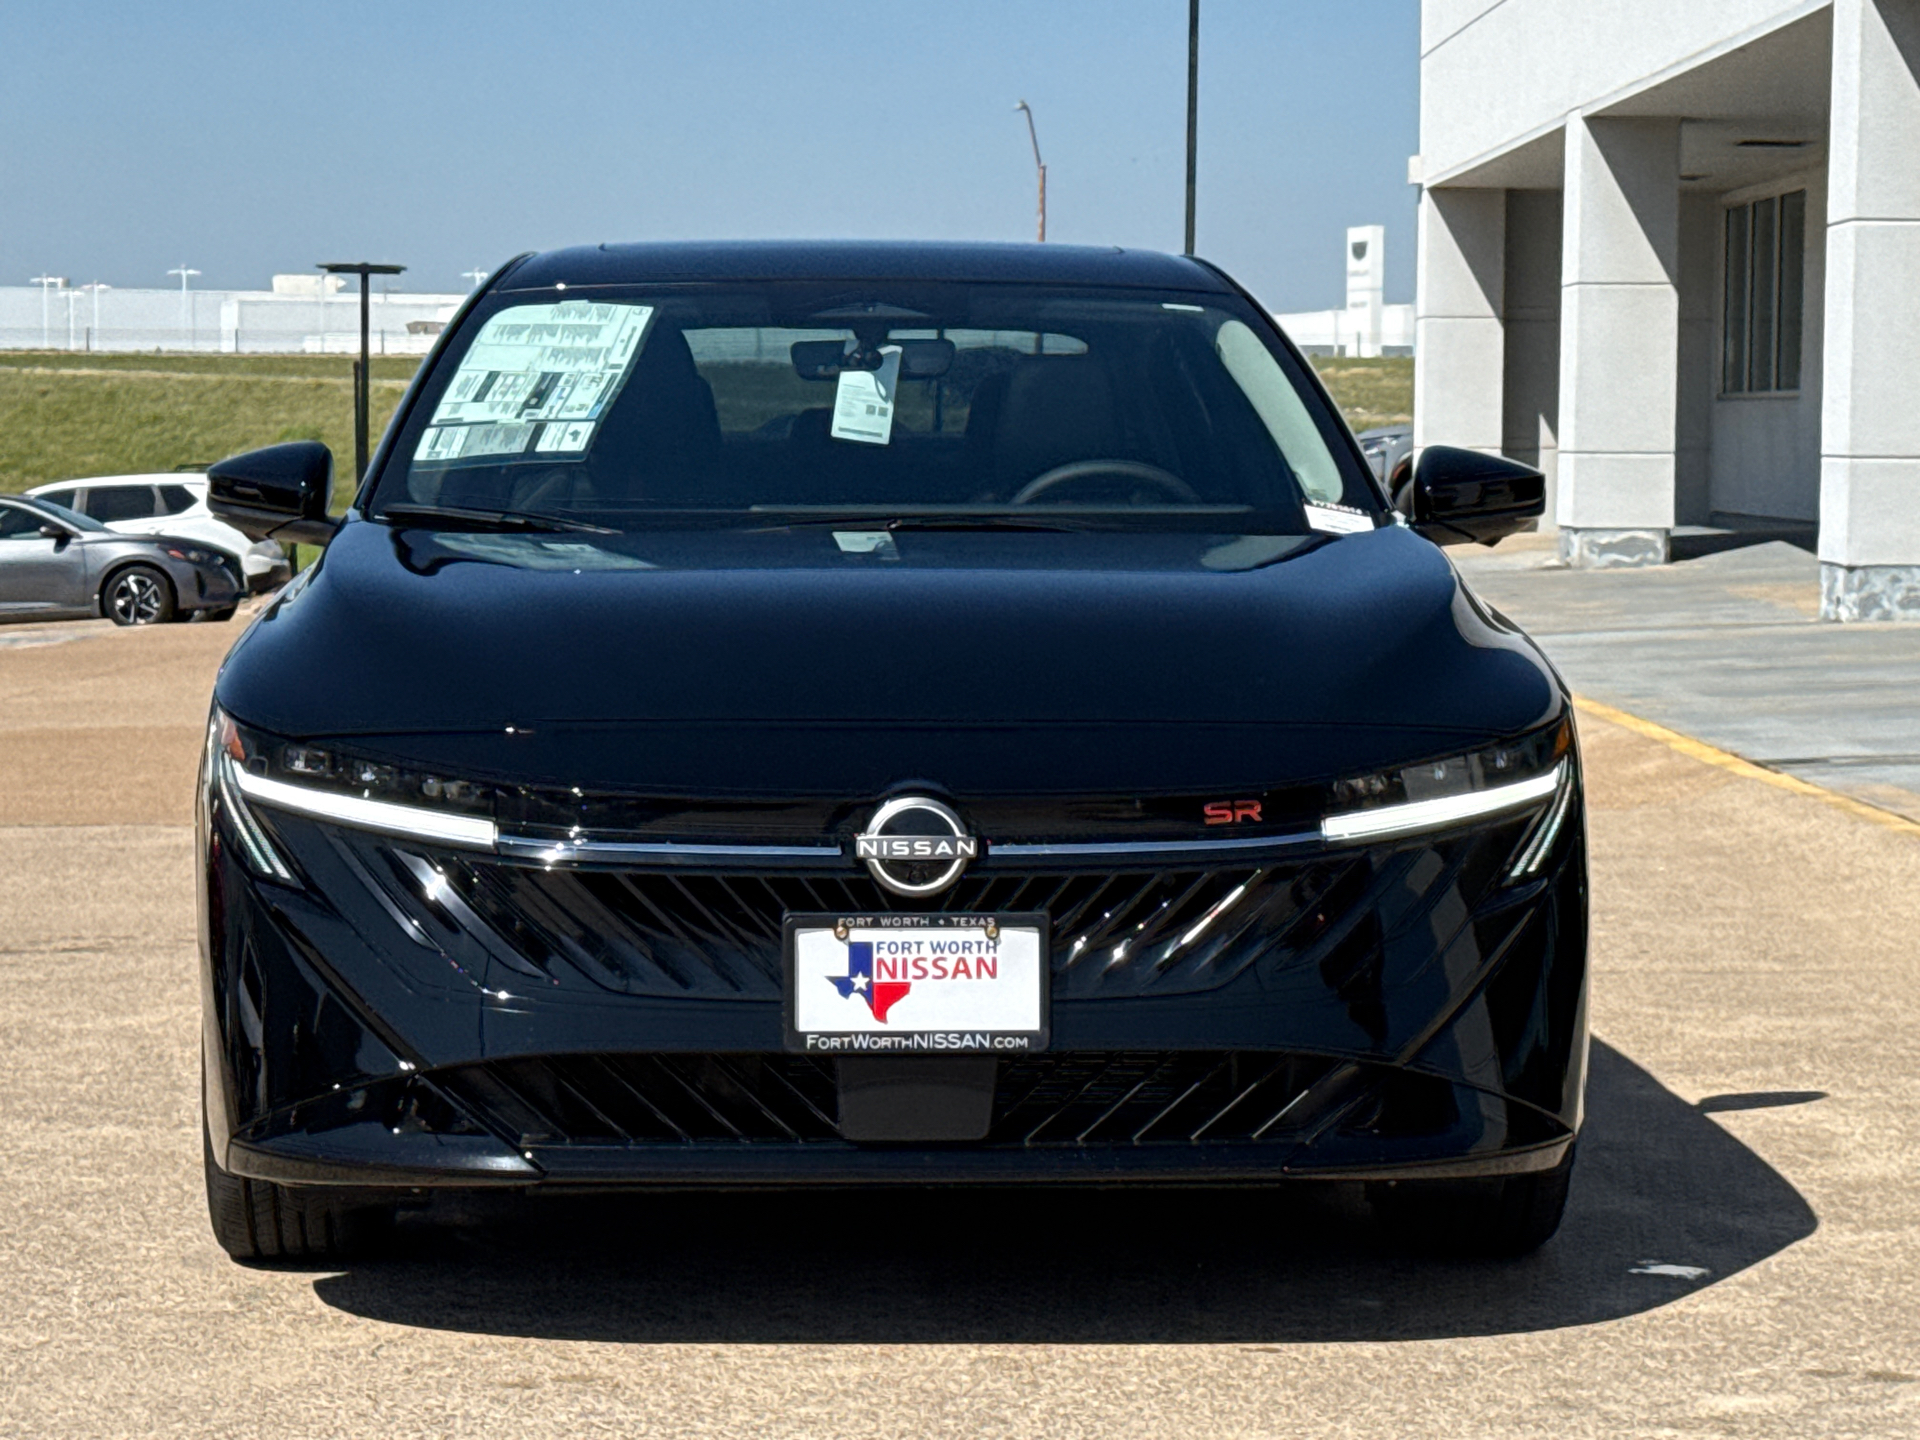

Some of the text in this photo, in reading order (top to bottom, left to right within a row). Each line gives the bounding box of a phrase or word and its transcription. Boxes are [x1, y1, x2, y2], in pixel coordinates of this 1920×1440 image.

[1204, 800, 1263, 825] SR
[859, 840, 975, 856] NISSAN
[838, 916, 995, 927] FORT WORTH TEXAS
[876, 940, 998, 955] FORT WORTH
[876, 956, 998, 980] NISSAN
